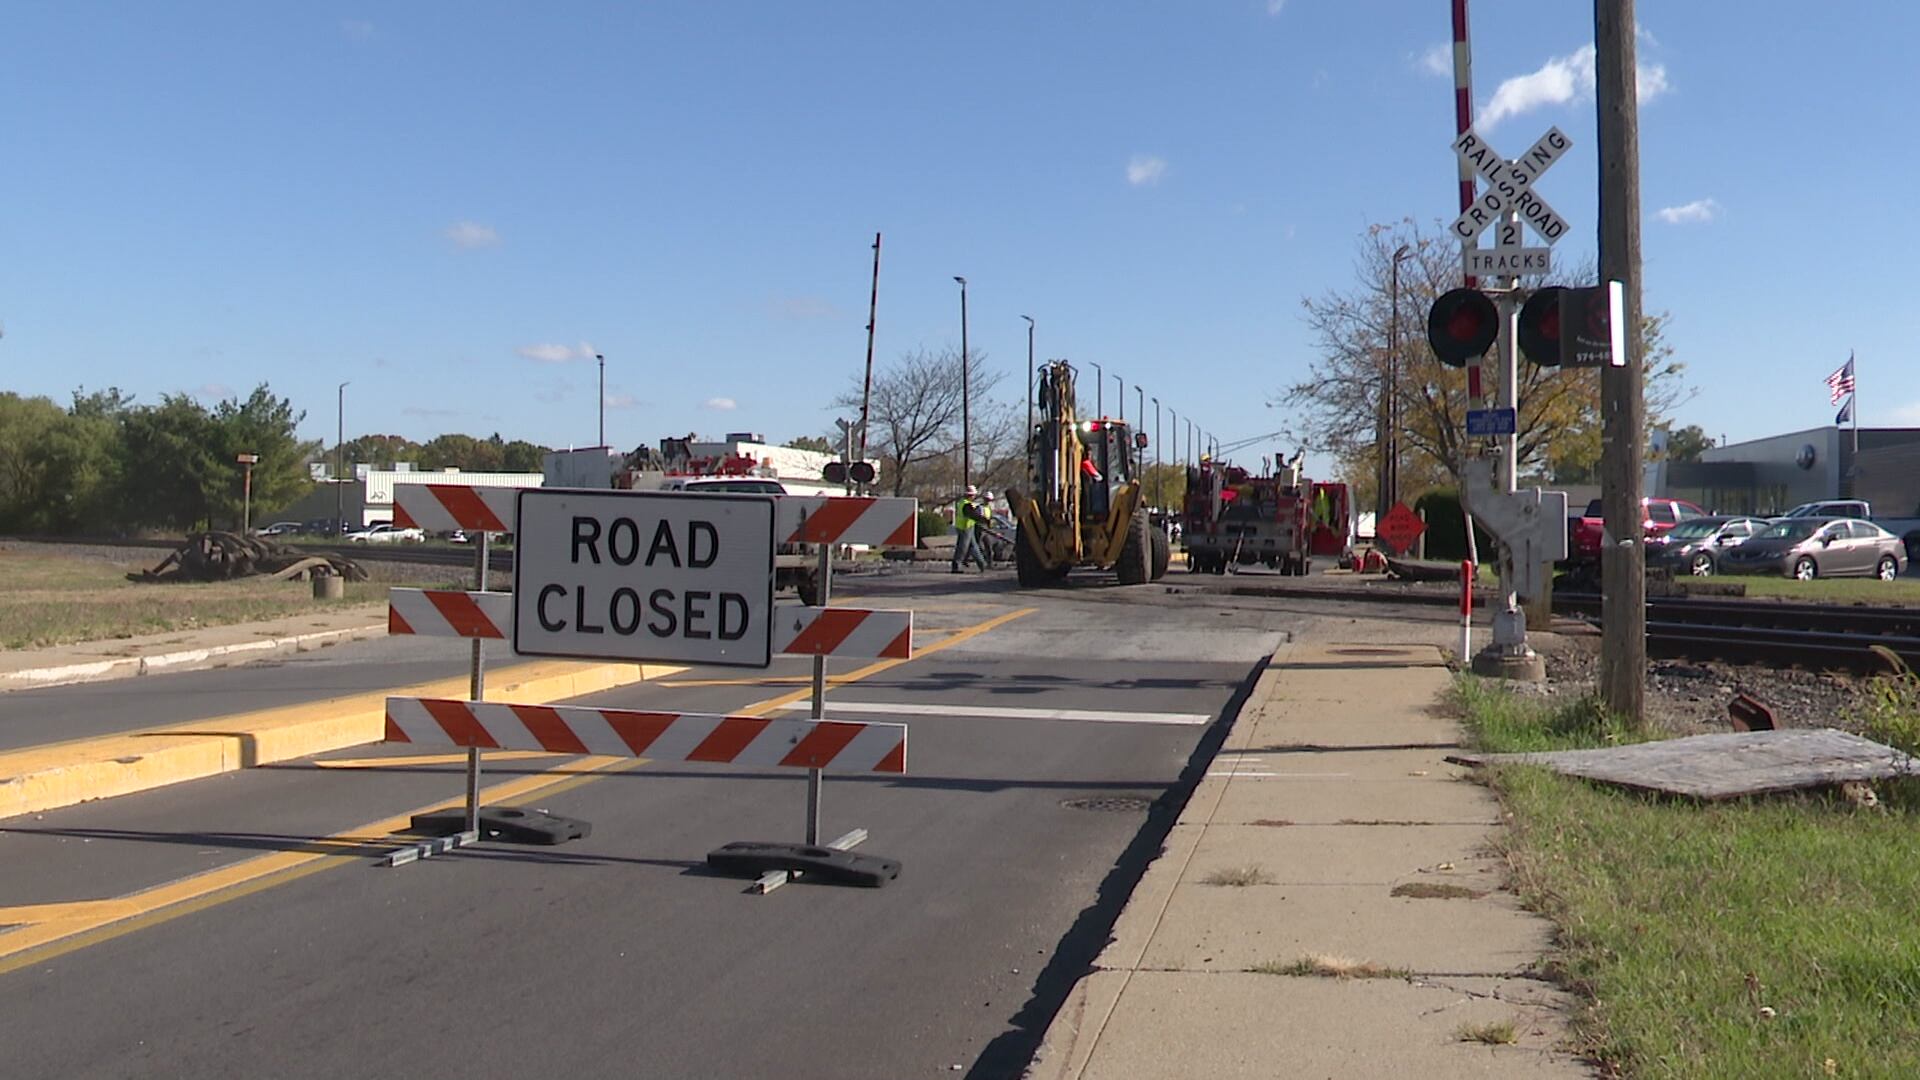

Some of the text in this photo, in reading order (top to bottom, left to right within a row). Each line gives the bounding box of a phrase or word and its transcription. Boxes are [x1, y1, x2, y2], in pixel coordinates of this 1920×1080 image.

[1457, 132, 1565, 238] CROSSING
[1472, 254, 1546, 269] TRACKS
[1502, 226, 1515, 245] 2
[571, 516, 720, 569] ROAD
[537, 583, 749, 641] CLOSED
